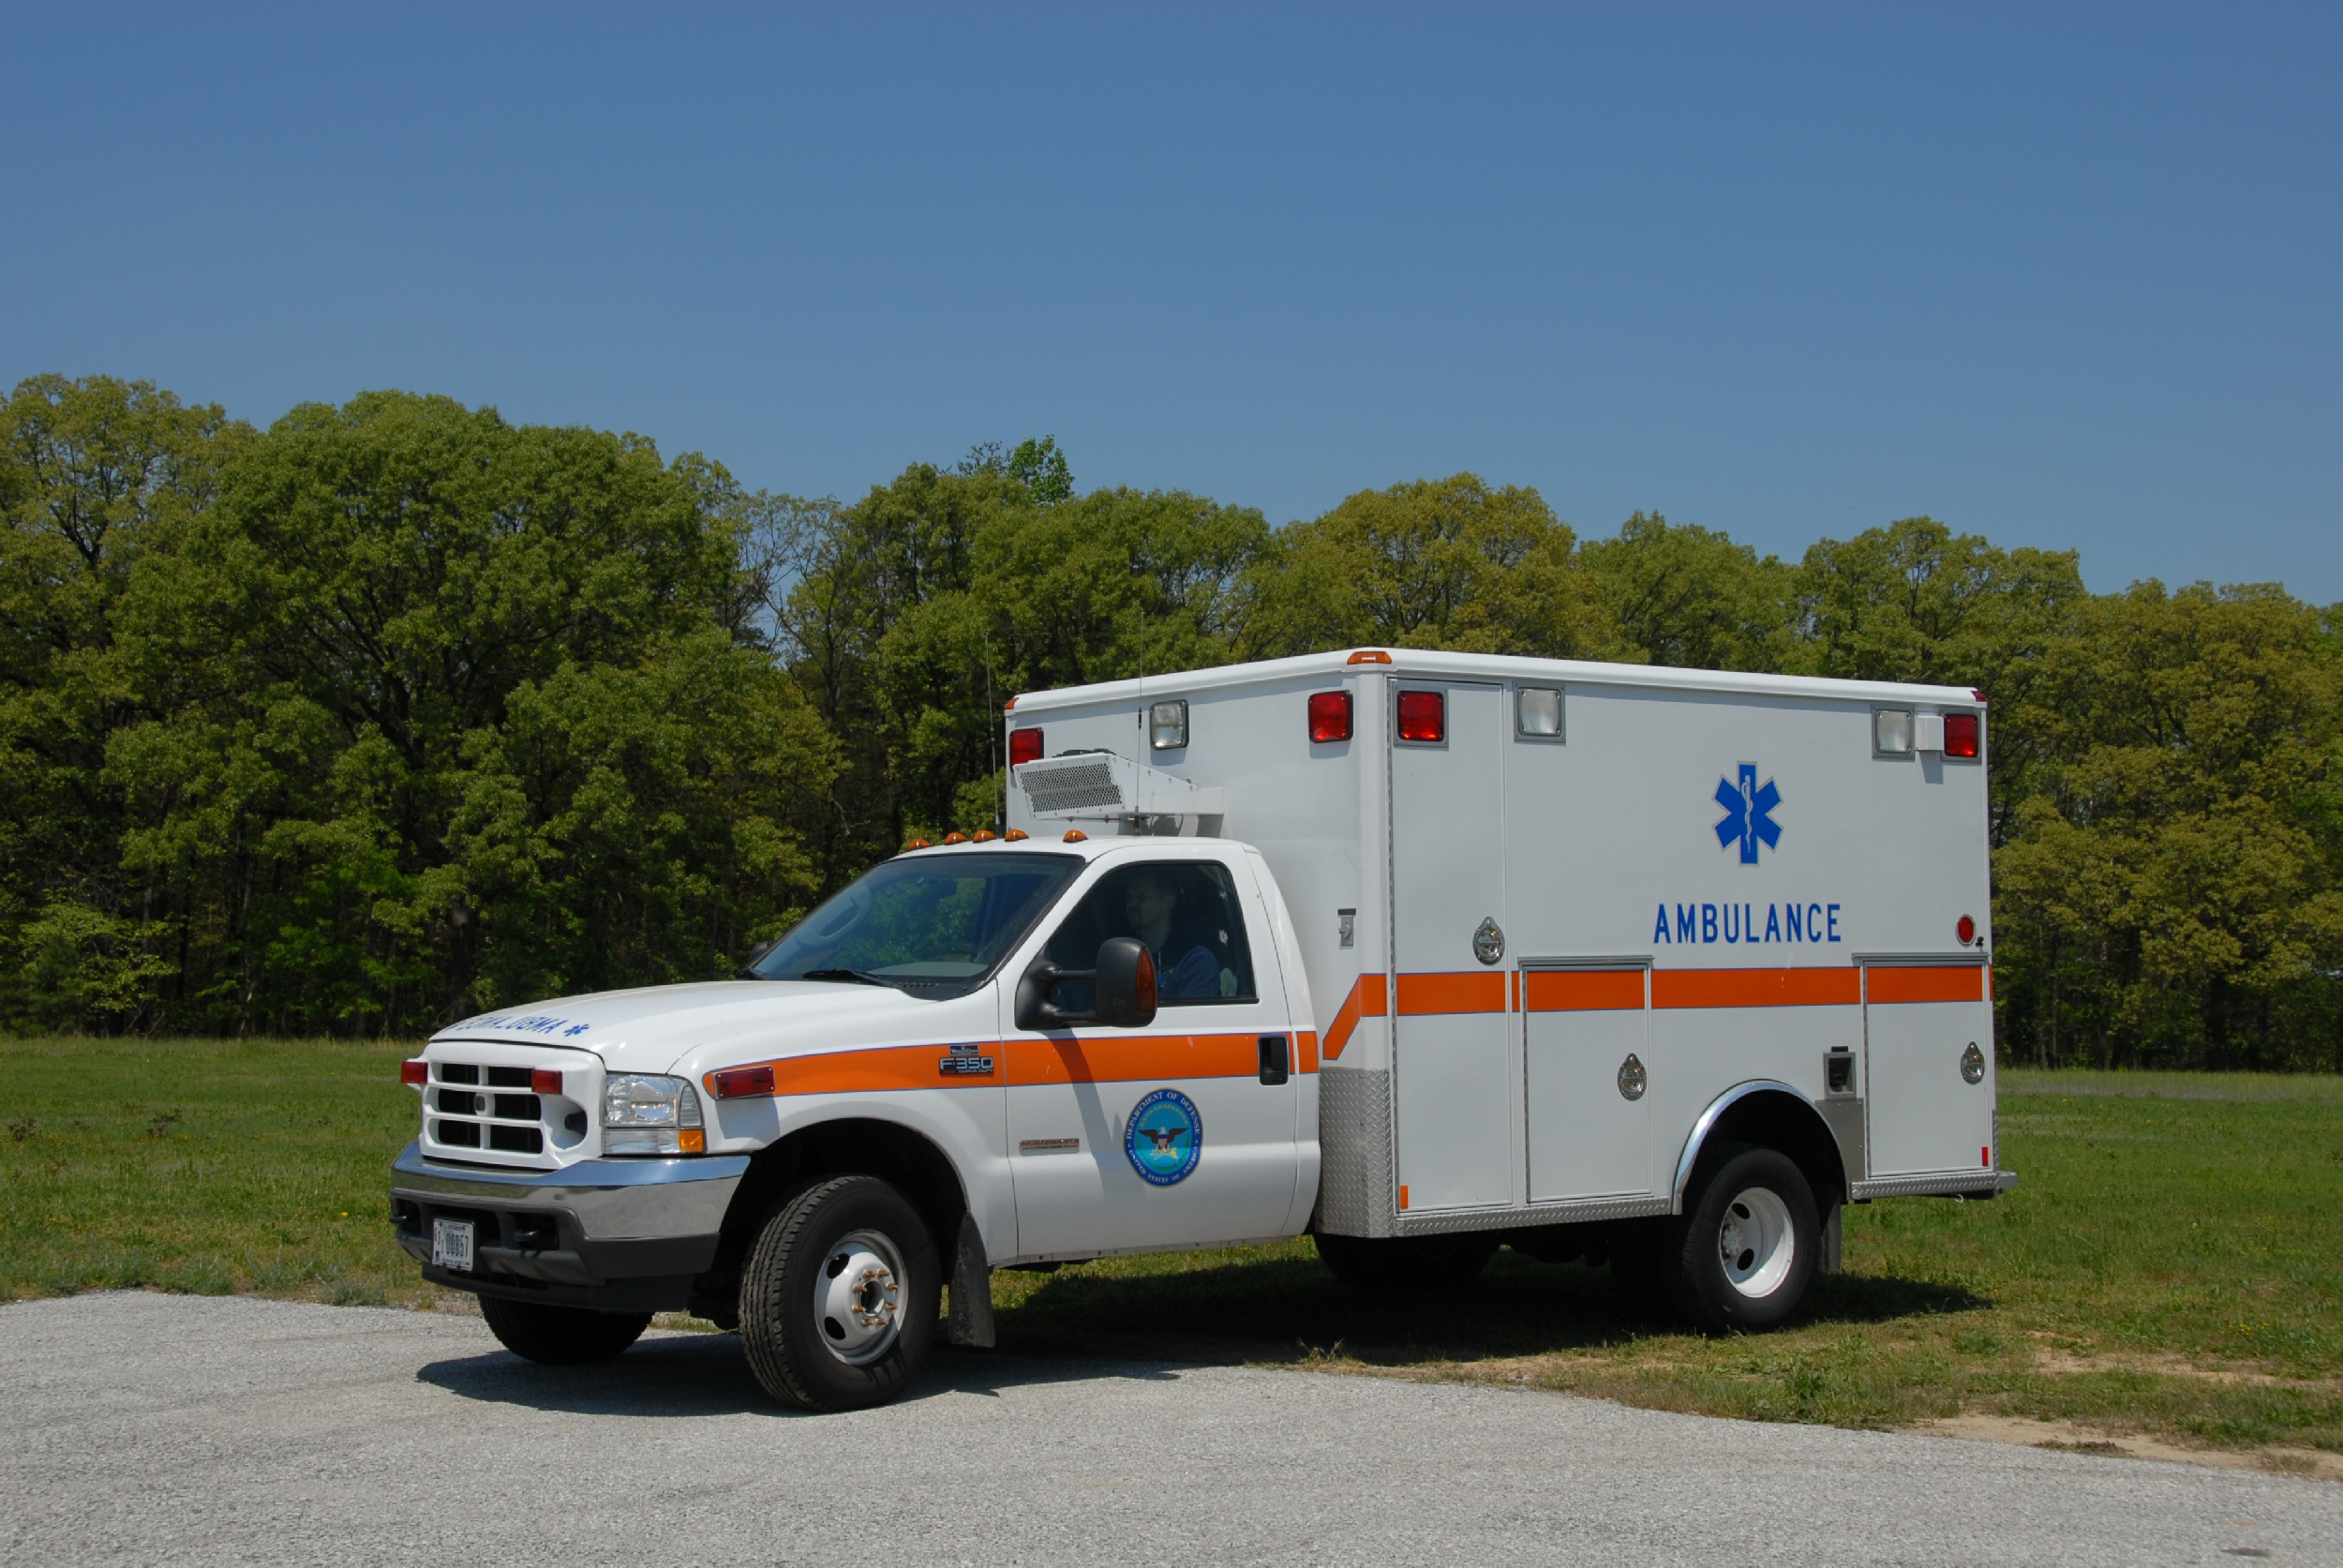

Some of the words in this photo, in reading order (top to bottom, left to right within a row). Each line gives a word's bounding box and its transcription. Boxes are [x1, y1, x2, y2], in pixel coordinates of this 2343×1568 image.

[1653, 903, 1842, 944] AMBULANCE
[1127, 1092, 1163, 1139] DEPARTMENT
[1167, 1092, 1178, 1100] OF
[1181, 1098, 1200, 1135] DEFENSE
[1129, 1150, 1146, 1174] UNITED
[1148, 1173, 1169, 1183] STATES
[1184, 1146, 1198, 1174] AMERICA
